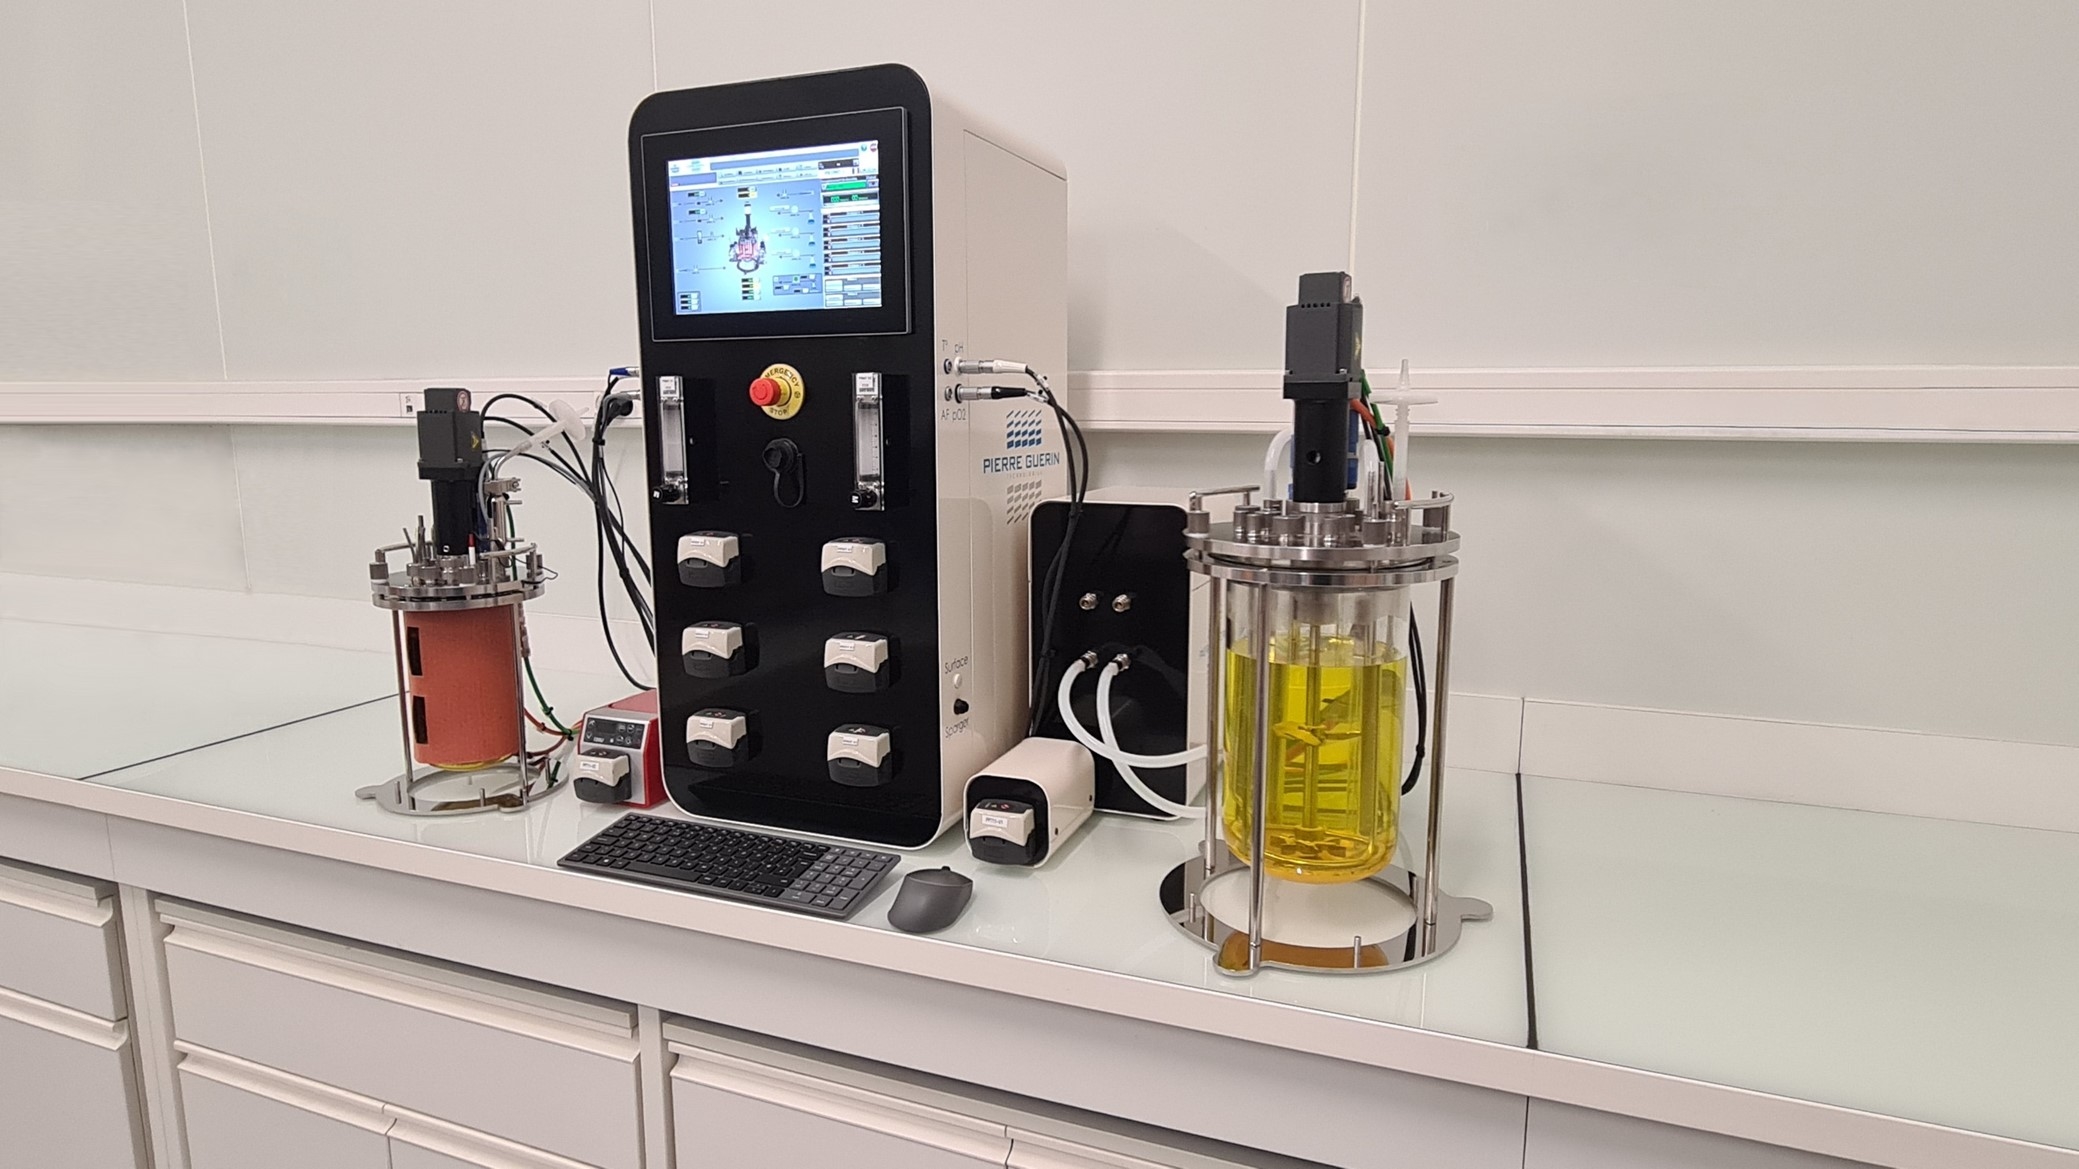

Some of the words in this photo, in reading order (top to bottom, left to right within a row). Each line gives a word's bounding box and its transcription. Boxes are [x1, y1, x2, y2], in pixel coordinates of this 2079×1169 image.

[769, 407, 788, 416] STOP
[952, 408, 967, 422] pO2
[983, 455, 1022, 474] PIERRE
[1025, 452, 1060, 469] GUERIN
[945, 656, 968, 674] Surface
[945, 718, 969, 738] Sparger
